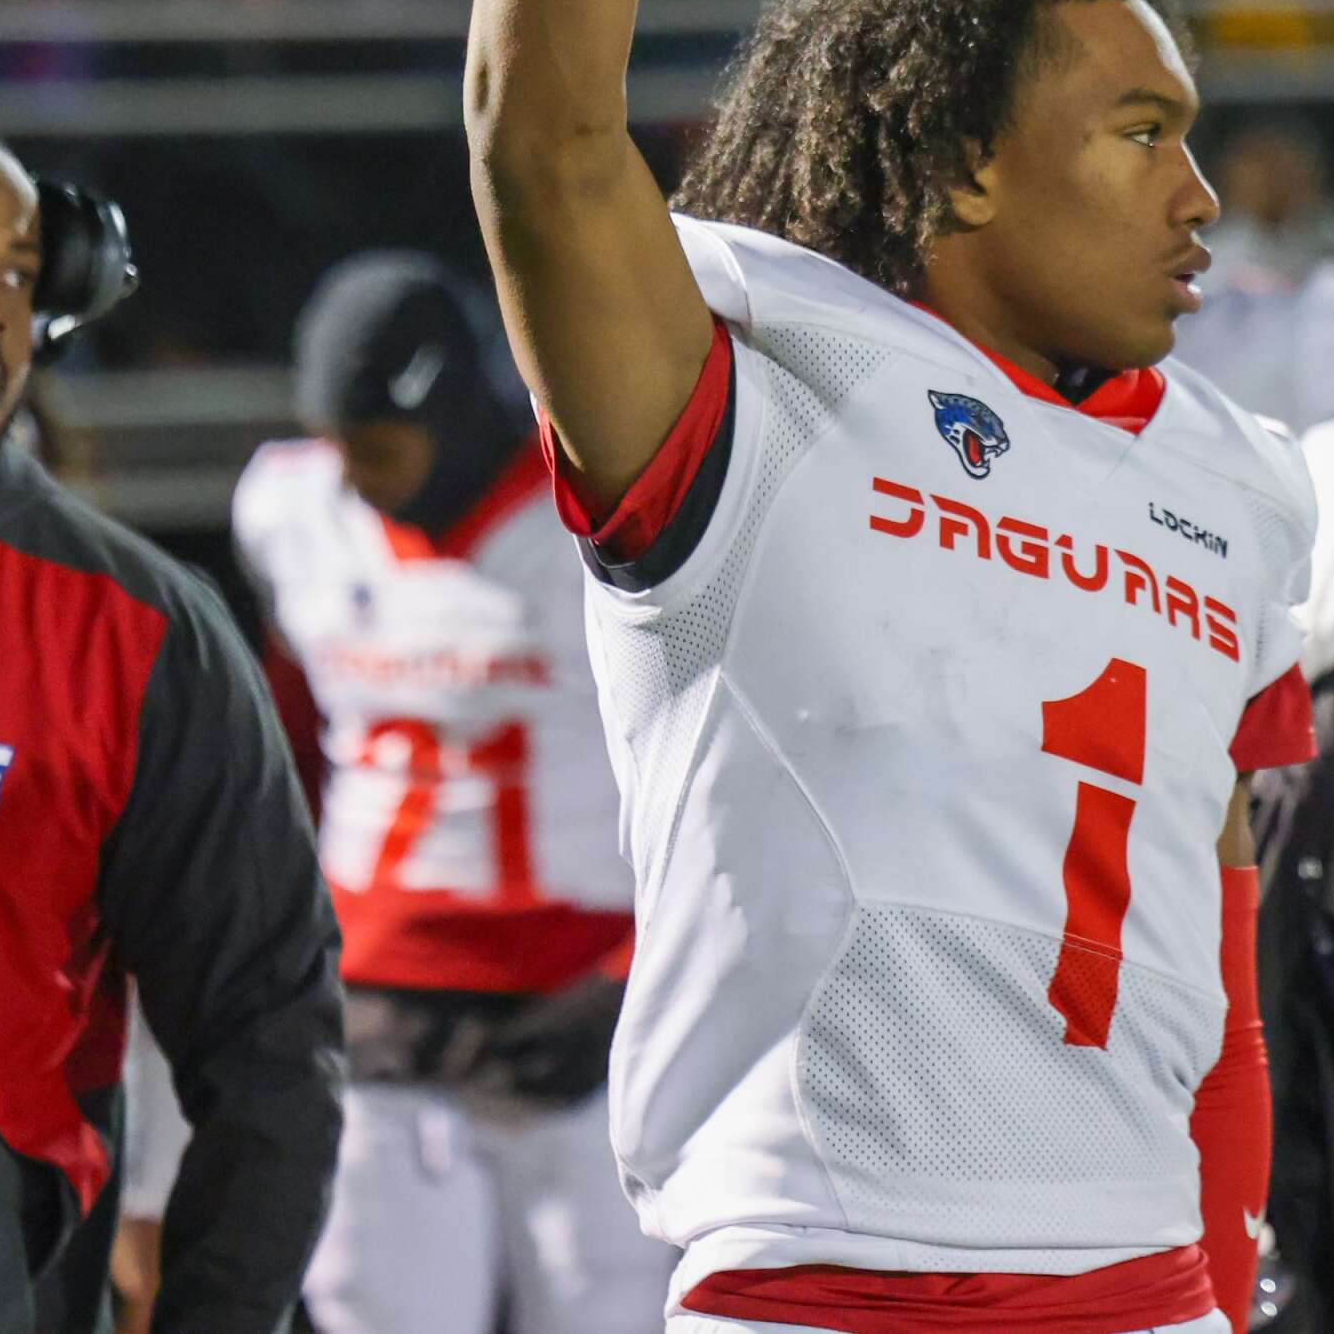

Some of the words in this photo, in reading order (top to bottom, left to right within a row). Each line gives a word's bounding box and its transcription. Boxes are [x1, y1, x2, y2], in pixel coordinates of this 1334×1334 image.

[869, 477, 1240, 662] JAGUARS
[1148, 502, 1228, 559] LOCKIN
[1041, 657, 1147, 1051] 1
